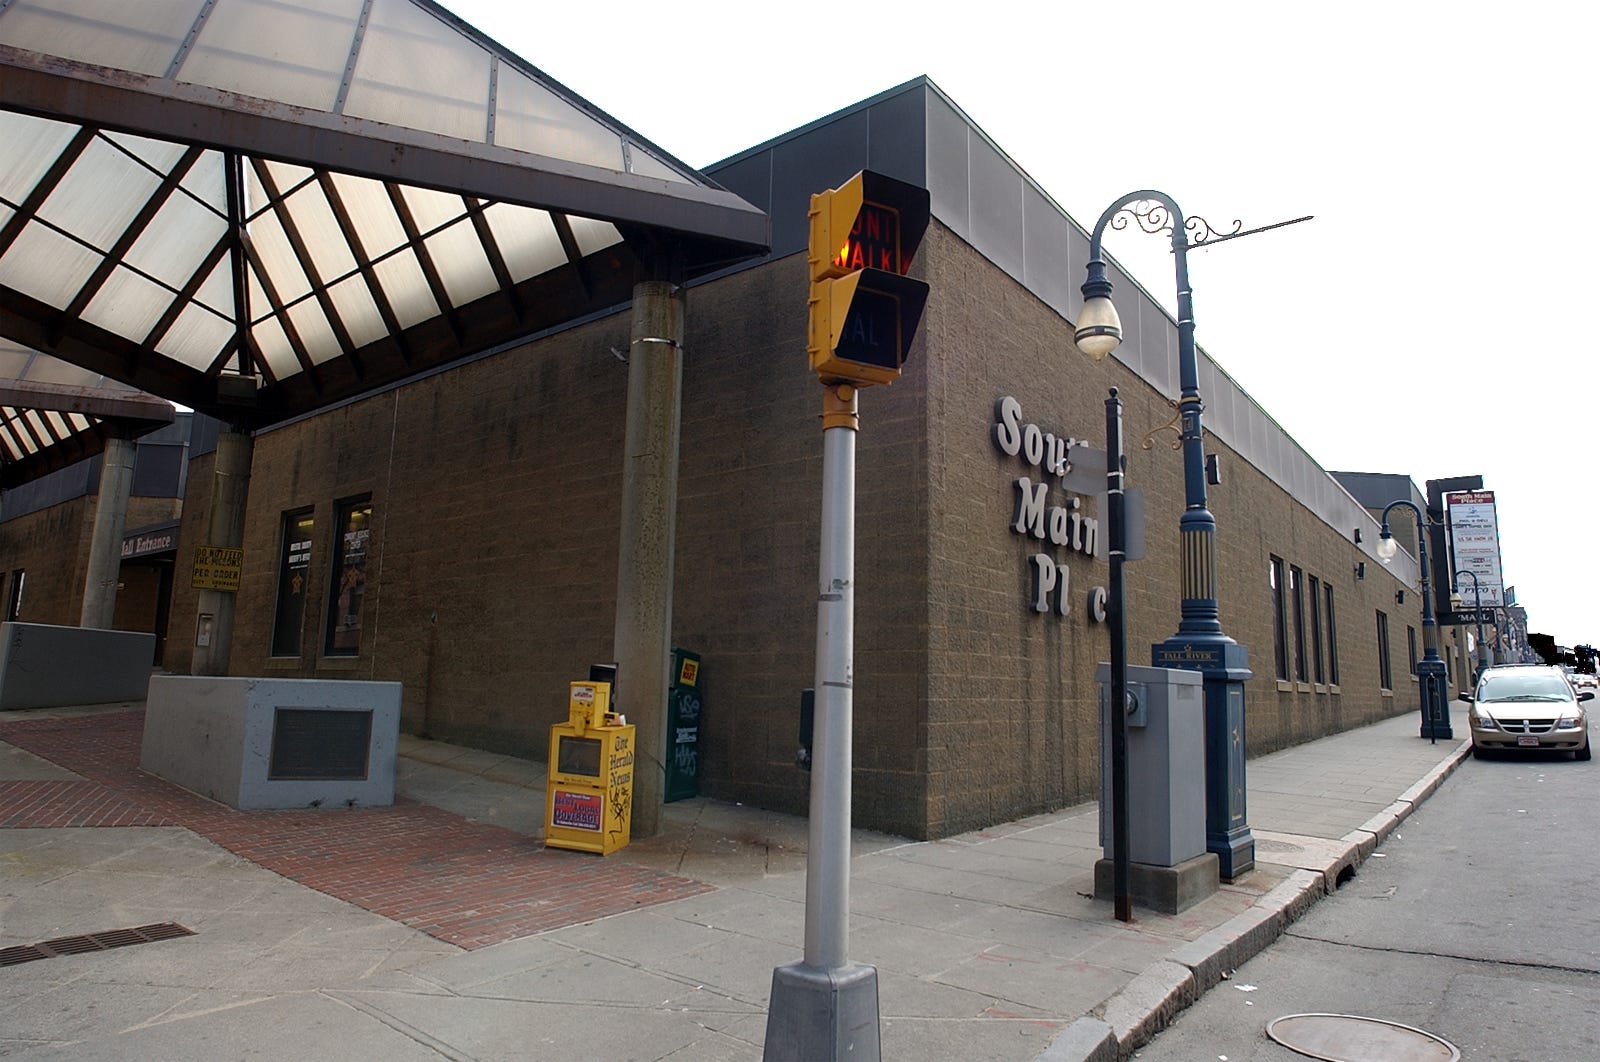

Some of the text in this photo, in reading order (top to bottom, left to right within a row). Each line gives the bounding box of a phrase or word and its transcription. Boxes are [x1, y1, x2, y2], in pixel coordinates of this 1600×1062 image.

[993, 396, 1088, 477] Sou
[1010, 476, 1099, 557] Main
[135, 536, 171, 553] Entrance
[196, 556, 209, 565] THE
[197, 548, 242, 560] DO NOT FEED
[194, 568, 238, 579] PER ORDER
[1458, 614, 1490, 622] MAL
[1164, 652, 1212, 660] FALL RIVER
[615, 736, 628, 751] The
[610, 750, 633, 770] Herald
[610, 771, 631, 788] News
[556, 809, 599, 825] COVERAGE
